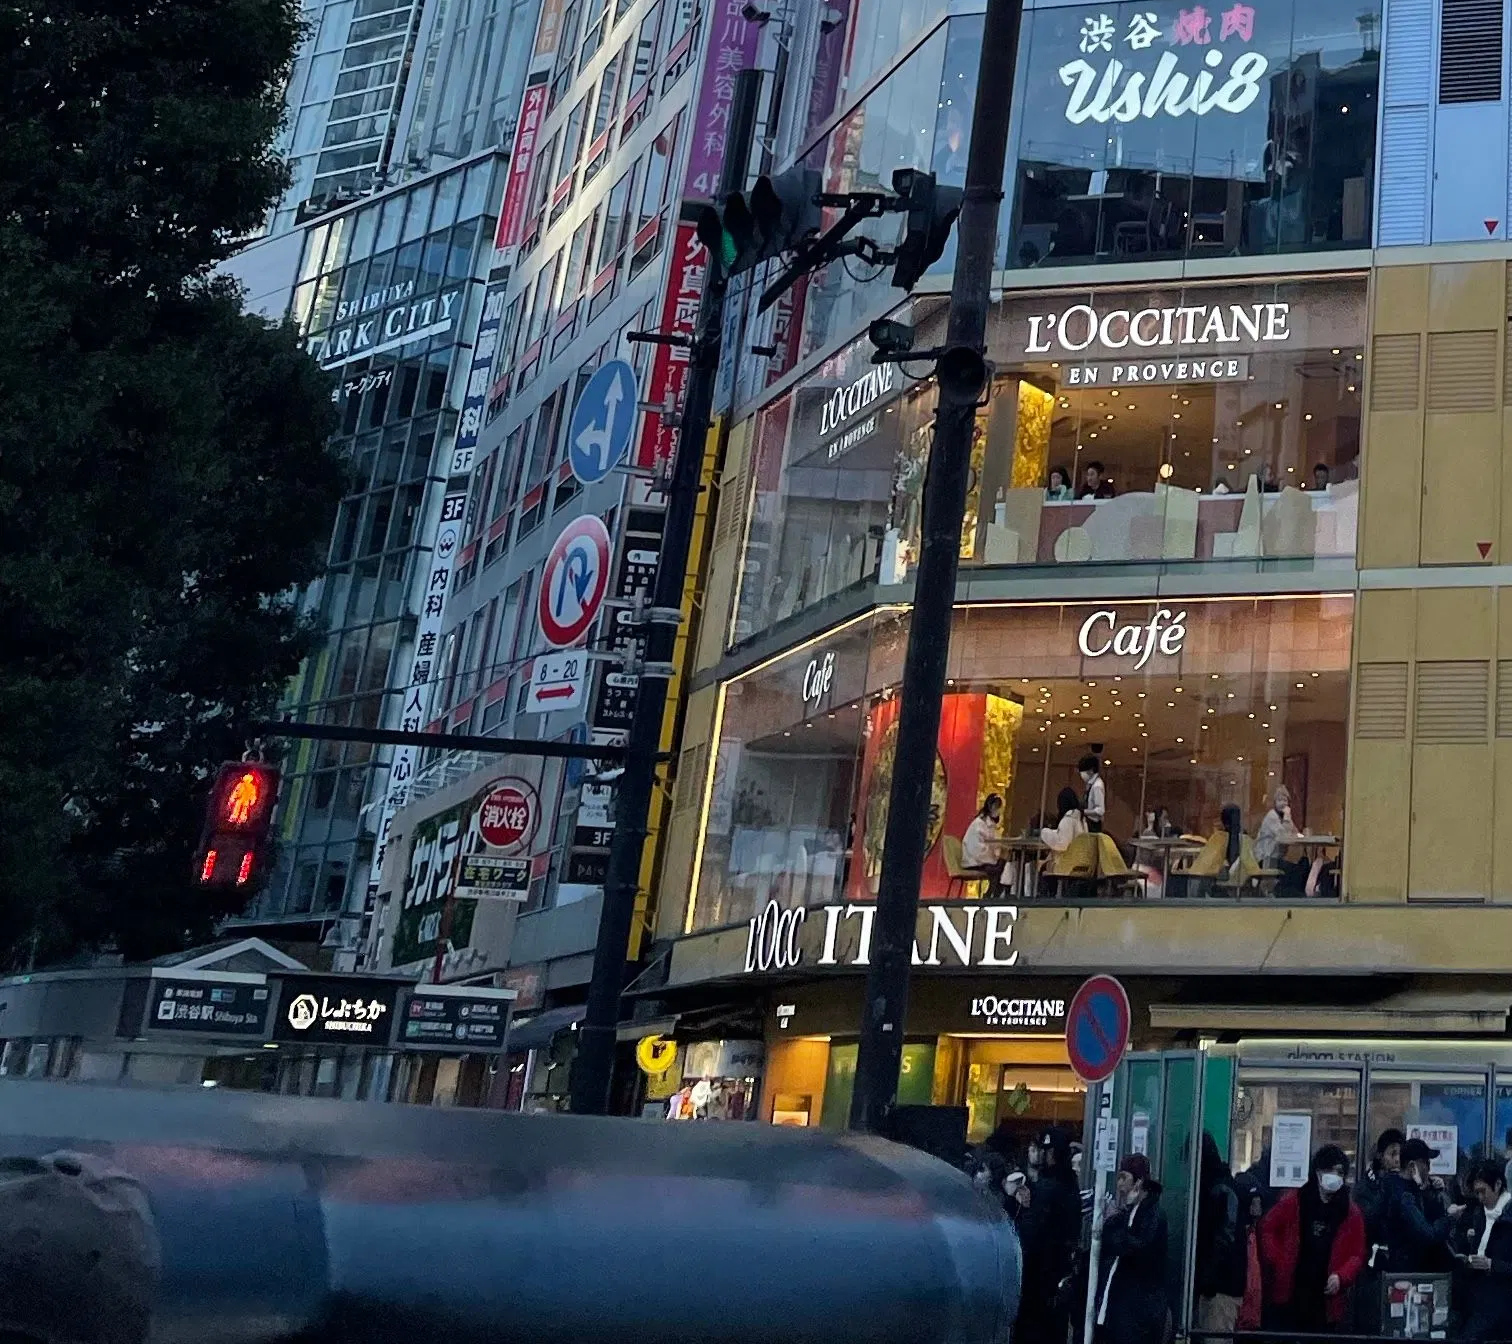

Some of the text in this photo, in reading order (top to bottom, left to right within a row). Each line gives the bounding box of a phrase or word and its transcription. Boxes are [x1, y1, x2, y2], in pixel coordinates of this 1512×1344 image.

[1058, 48, 1268, 126] Ushi8
[336, 280, 414, 321] SHIBUYA
[385, 291, 459, 337] CITY
[1025, 303, 1291, 354] L'OCCITANE
[1069, 358, 1240, 384] EN PROVENCE
[820, 361, 893, 436] L'OCCITANE
[454, 452, 473, 471] 5F
[443, 498, 464, 520] 3F
[426, 567, 449, 618] 内科
[1078, 610, 1187, 670] Café
[540, 663, 548, 681] 8
[563, 659, 578, 679] 20
[802, 652, 835, 704] Café
[482, 805, 527, 830] 消火栓
[592, 832, 612, 845] 3F
[321, 997, 387, 1020] しぶちか
[971, 995, 1065, 1017] L'OCCITANE
